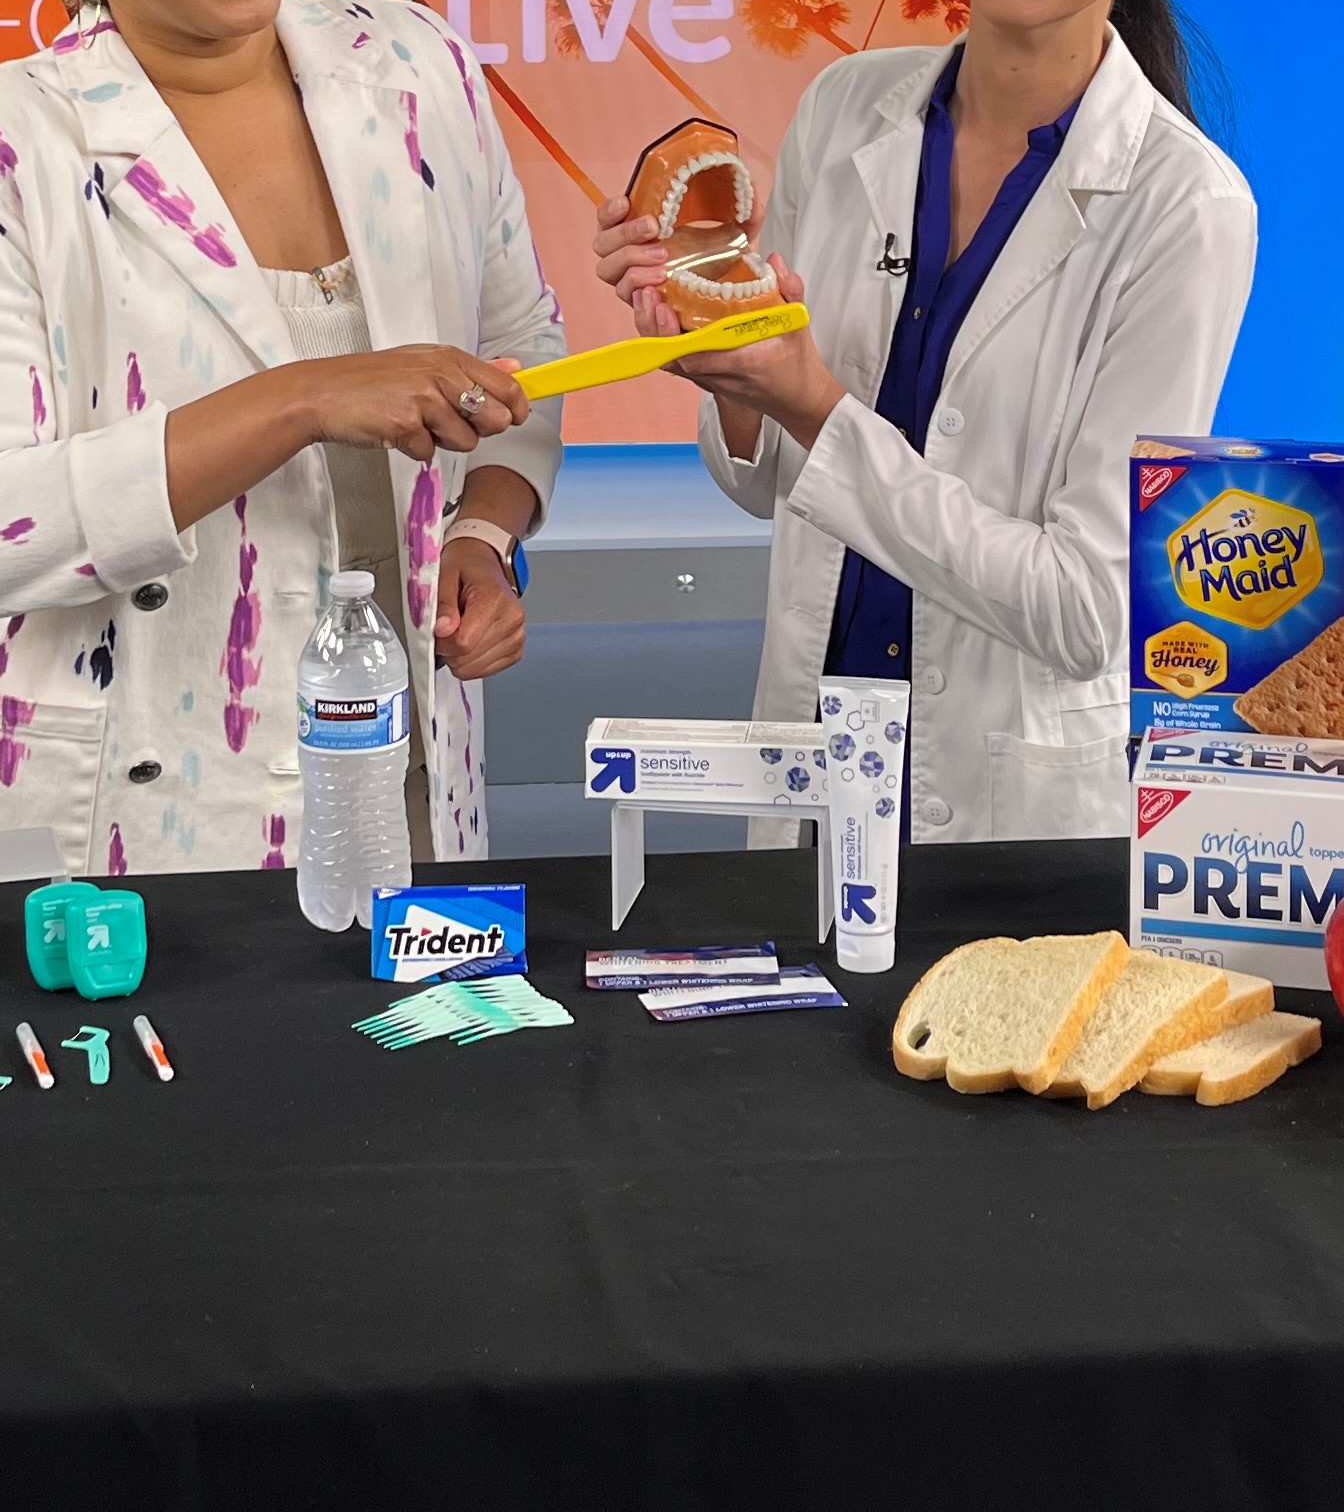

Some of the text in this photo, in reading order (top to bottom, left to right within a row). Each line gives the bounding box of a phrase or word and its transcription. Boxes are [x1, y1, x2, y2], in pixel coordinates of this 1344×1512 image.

[1144, 468, 1170, 495] NABISCO
[1176, 523, 1307, 573] Honey
[1199, 554, 1298, 602] Maid
[1150, 649, 1220, 676] Honey
[1173, 647, 1198, 655] REAL
[317, 702, 376, 714] KIRKLAND
[1153, 700, 1172, 717] NO
[1209, 740, 1310, 756] original
[640, 756, 710, 771] sensitive
[1142, 793, 1171, 819] NABISCO
[842, 816, 856, 879] sensitive
[1201, 820, 1306, 874] original
[388, 925, 504, 956] Trident
